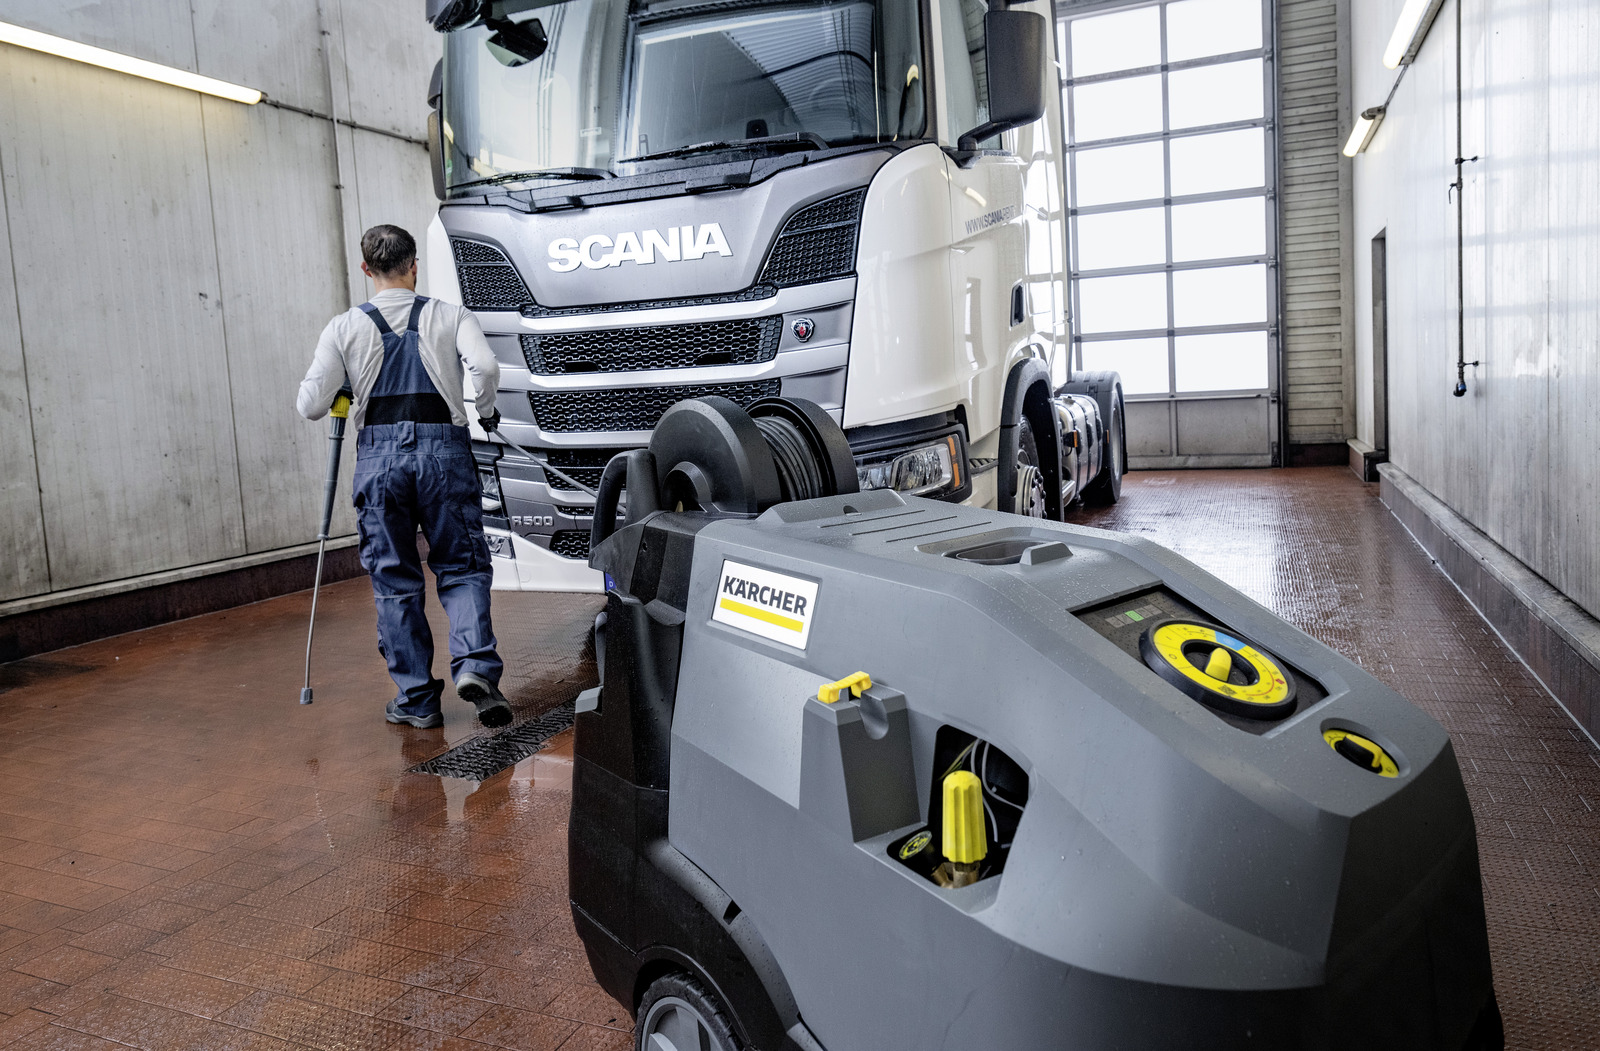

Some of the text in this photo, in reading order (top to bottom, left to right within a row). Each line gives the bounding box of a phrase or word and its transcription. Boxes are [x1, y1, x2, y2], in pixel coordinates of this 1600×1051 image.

[547, 222, 733, 273] SCANIA
[511, 515, 554, 527] R500
[722, 575, 807, 616] KÄRCHER
